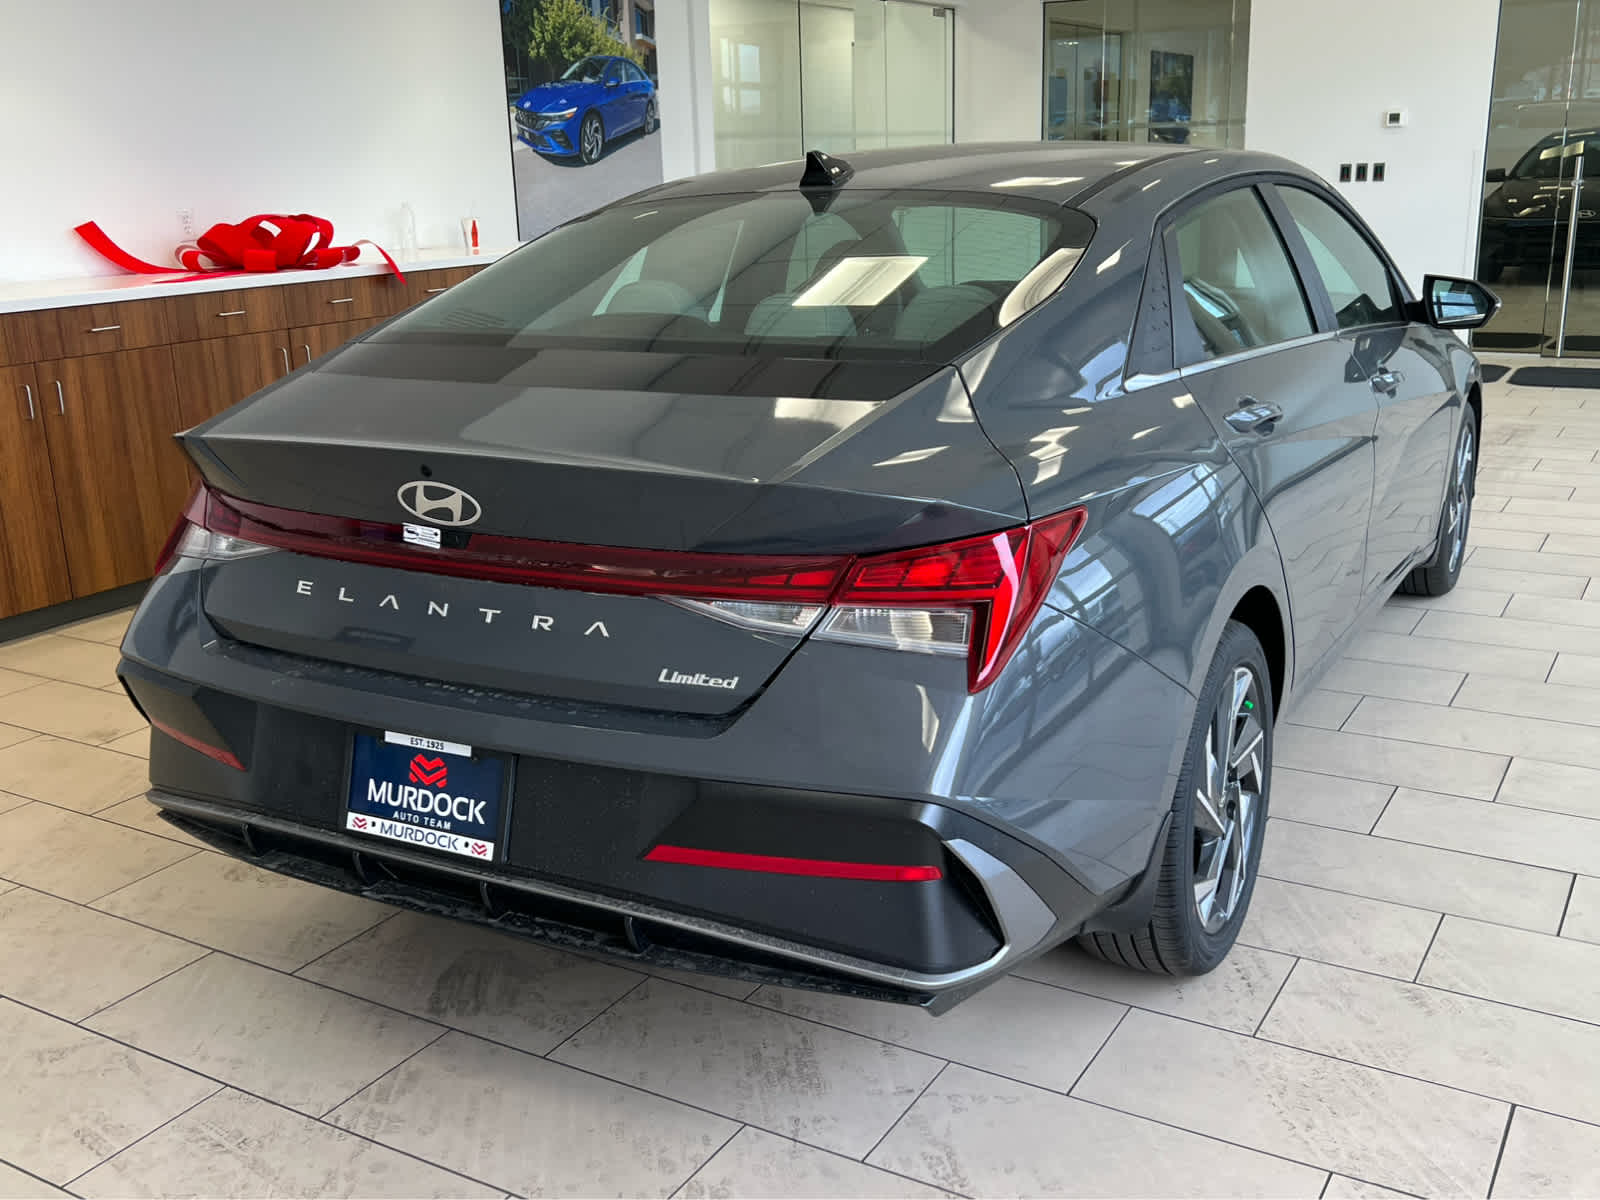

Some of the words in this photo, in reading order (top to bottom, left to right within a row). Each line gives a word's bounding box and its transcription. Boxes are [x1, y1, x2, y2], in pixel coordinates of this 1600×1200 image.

[296, 579, 610, 638] ELANTRA
[658, 668, 739, 690] Limited
[410, 737, 425, 747] EST.
[426, 739, 445, 750] 1925
[367, 778, 487, 825] MURDOCK
[392, 811, 420, 824] AUTO
[423, 816, 452, 831] TEAM
[379, 820, 459, 851] MURDOCK
